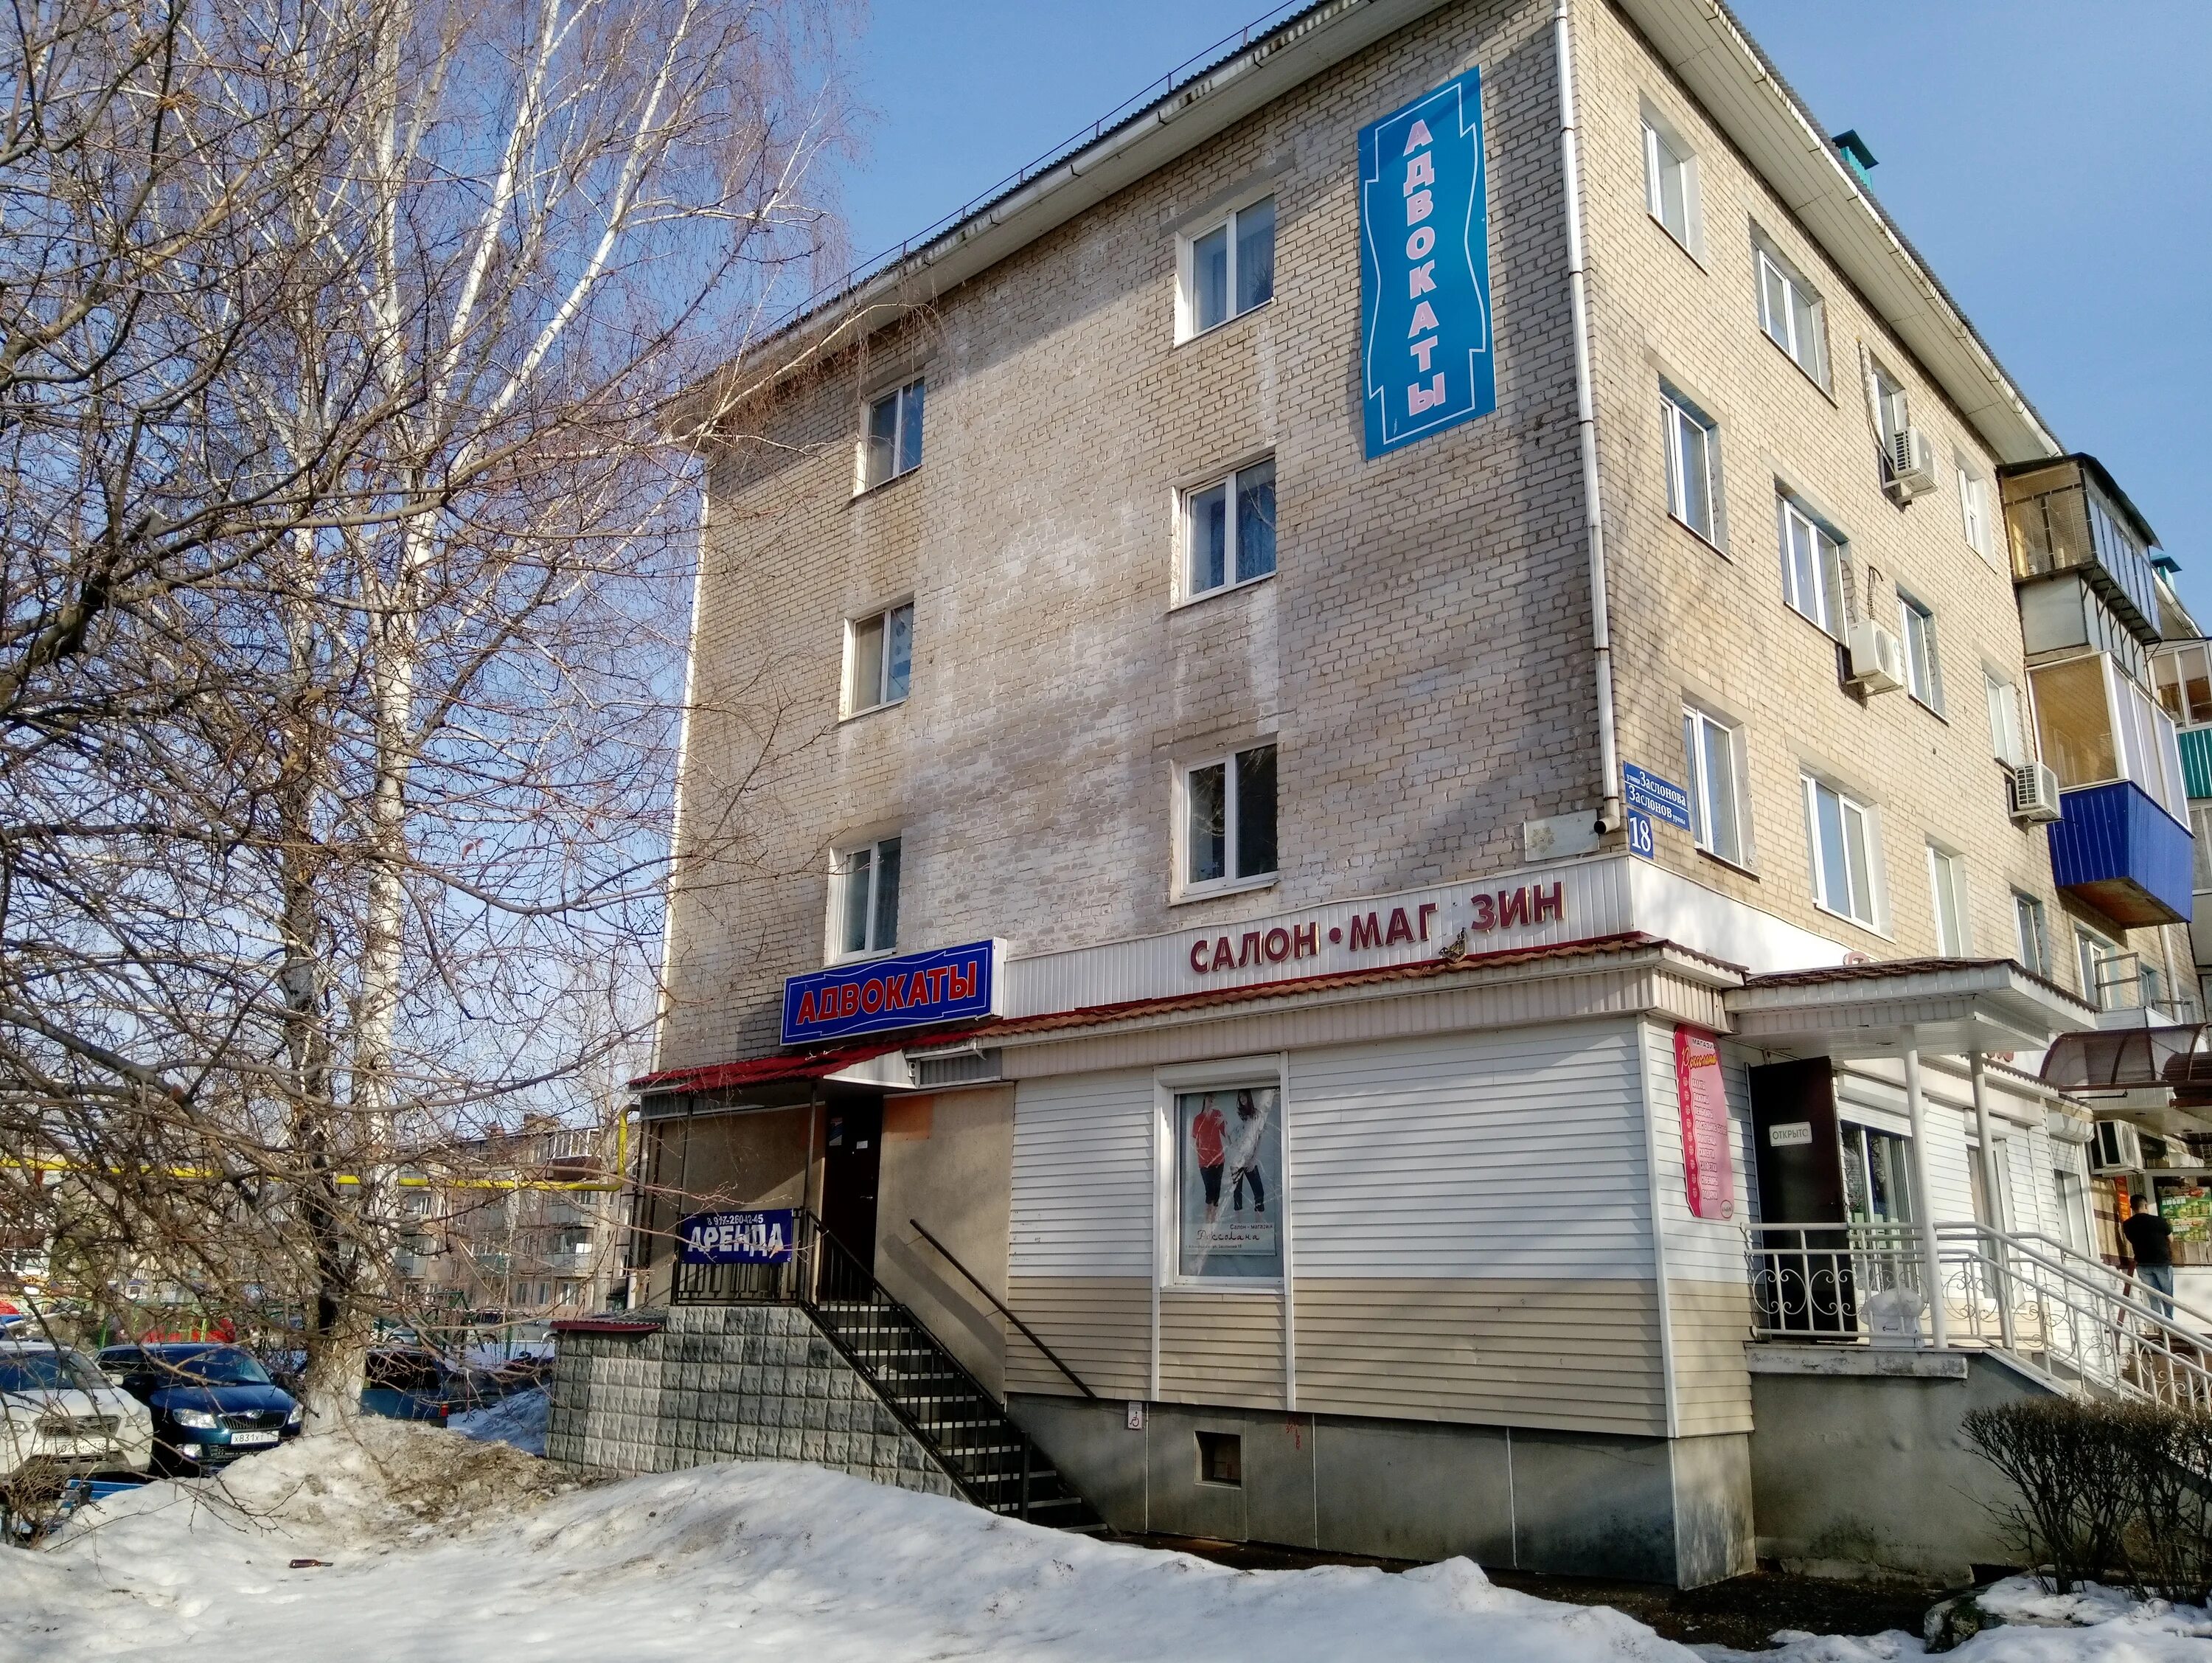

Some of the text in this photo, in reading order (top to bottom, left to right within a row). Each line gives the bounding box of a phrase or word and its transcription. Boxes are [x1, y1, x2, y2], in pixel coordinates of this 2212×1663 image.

[1402, 119, 1447, 417] АДВОКАТЫ
[1629, 785, 1672, 819] Заслонов
[1639, 771, 1686, 807] Заслонова
[1630, 816, 1652, 853] 18
[1190, 922, 1321, 974] САЛОН
[796, 960, 978, 1026] АДВОКАТЫ
[688, 1223, 784, 1258] АРЕНДА
